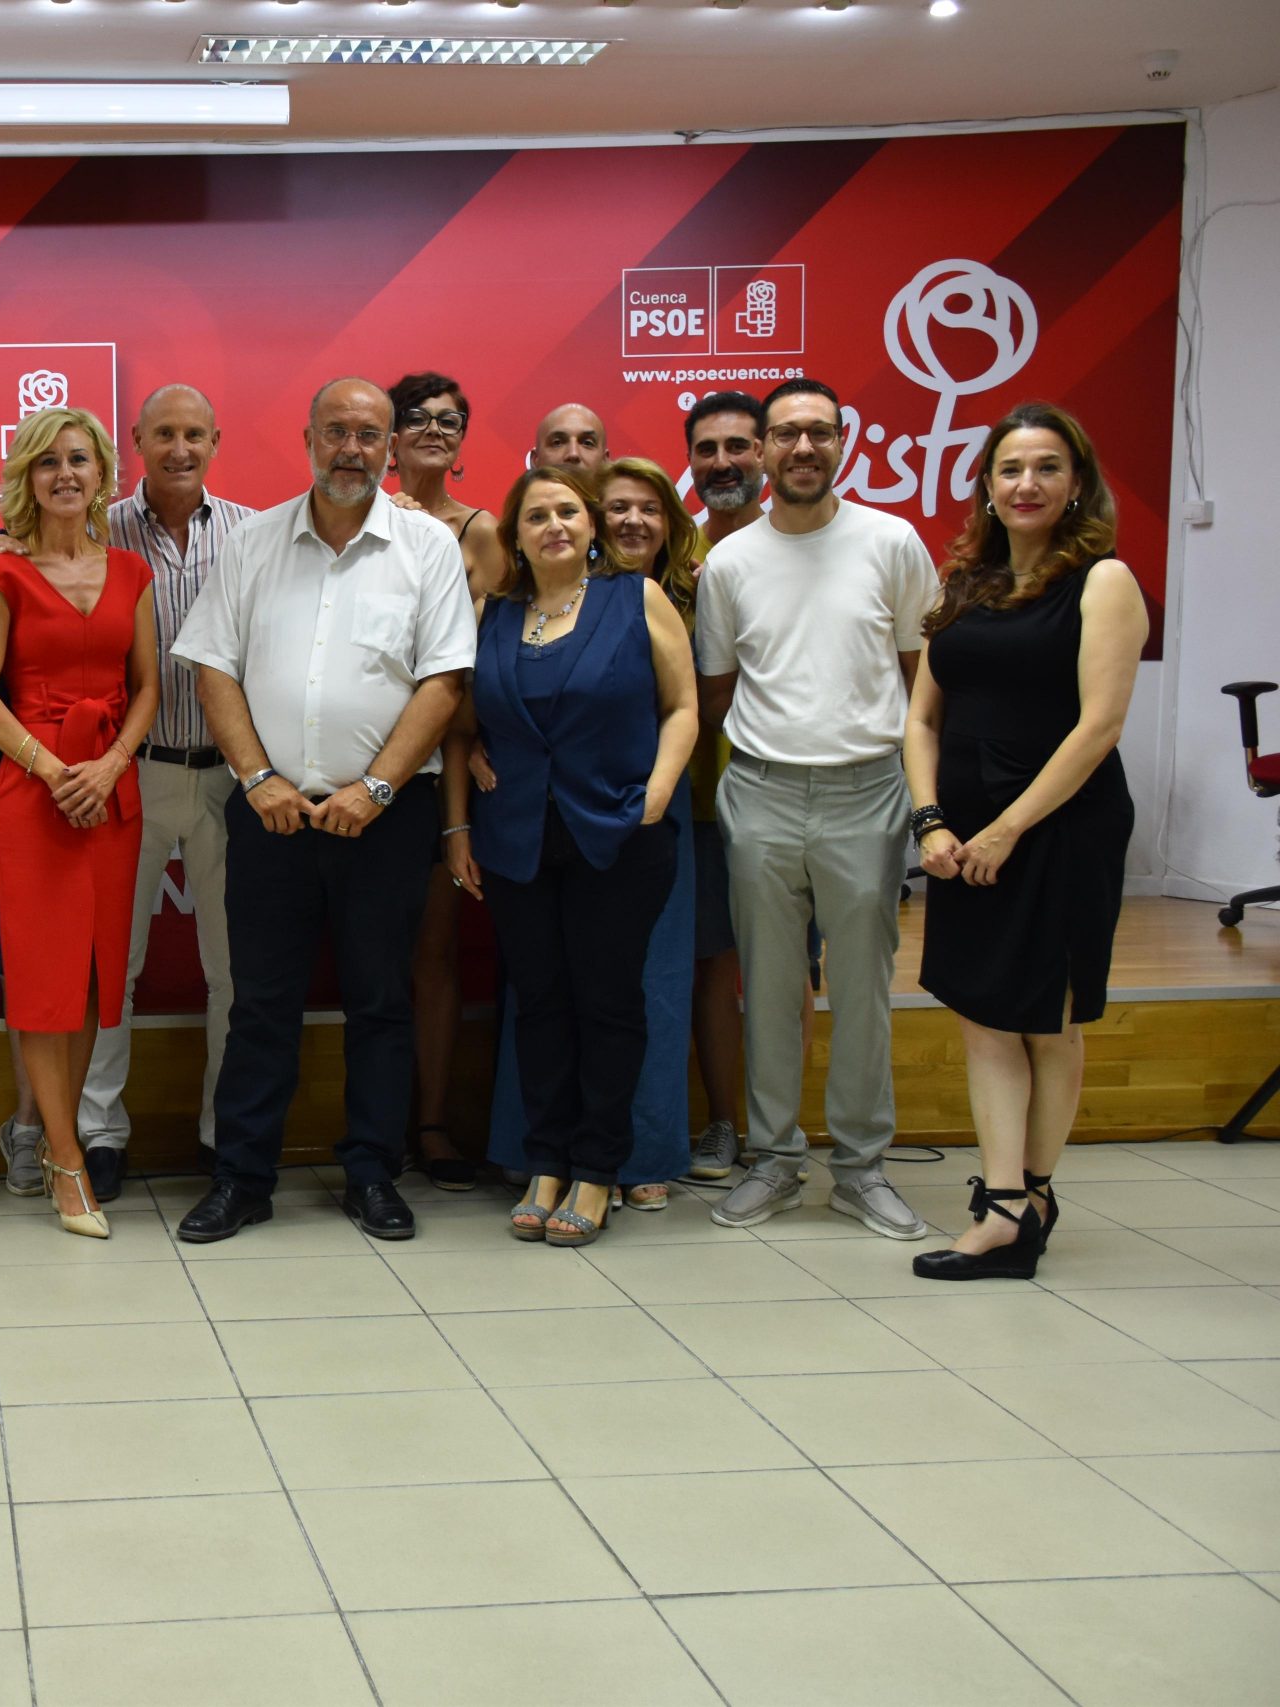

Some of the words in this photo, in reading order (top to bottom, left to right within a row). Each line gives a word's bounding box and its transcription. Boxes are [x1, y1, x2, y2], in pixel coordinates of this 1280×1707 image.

[630, 290, 687, 305] Cuenca
[630, 308, 705, 337] PSOE
[622, 365, 804, 384] www.psoecuenca.es
